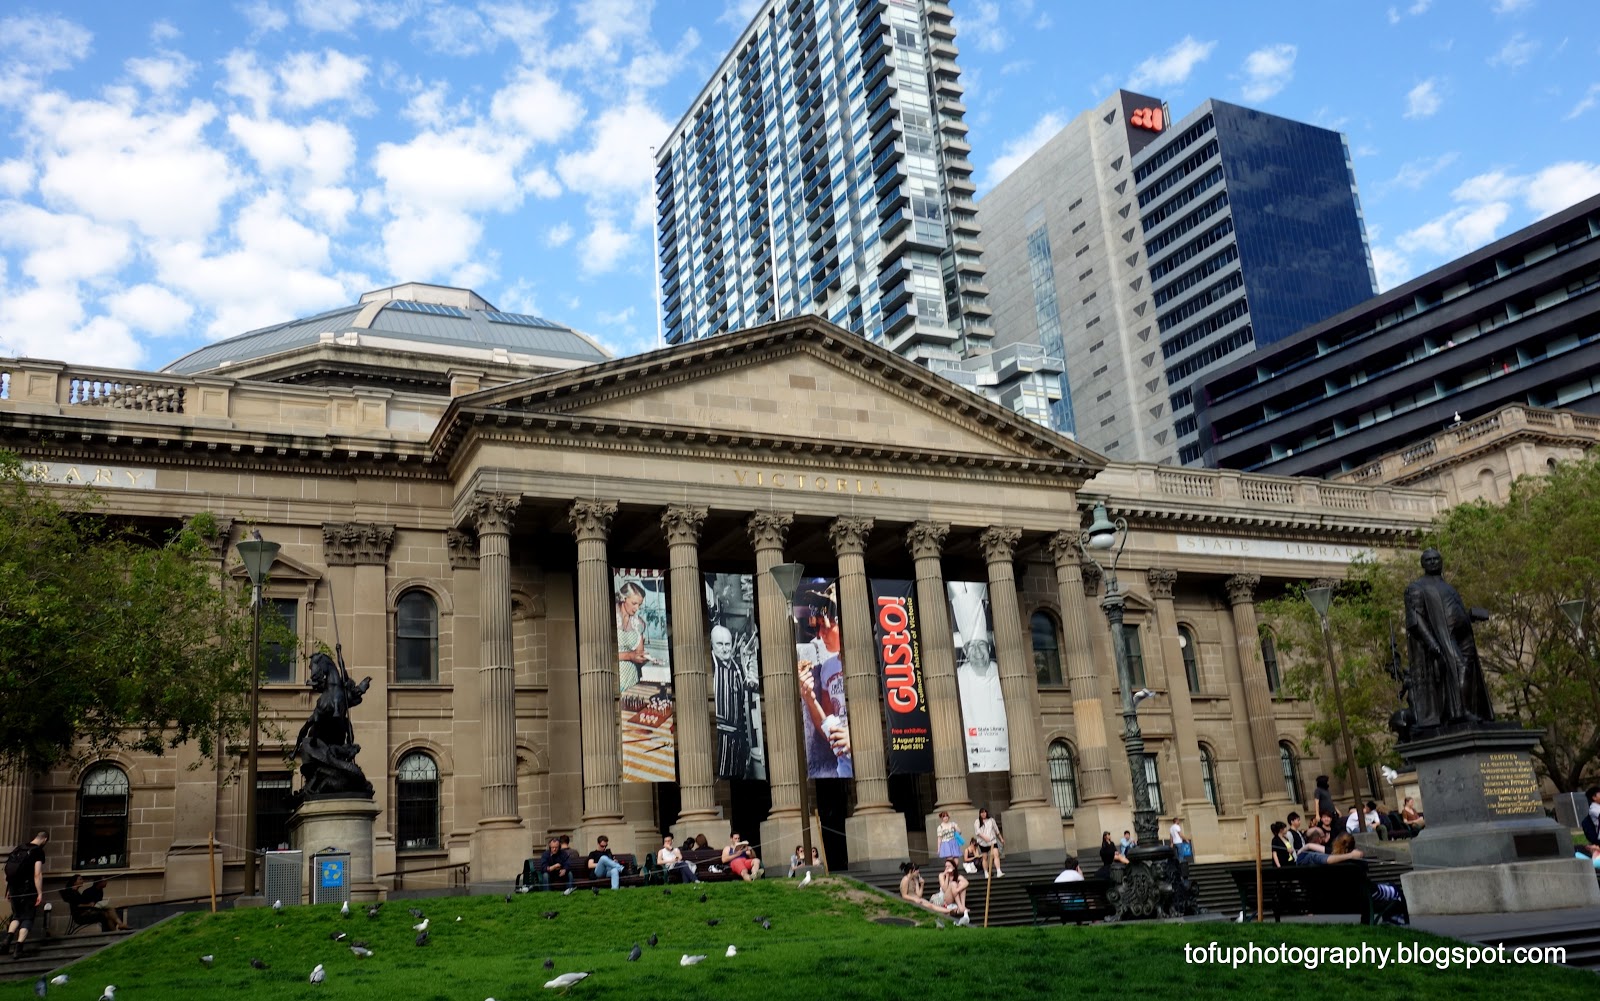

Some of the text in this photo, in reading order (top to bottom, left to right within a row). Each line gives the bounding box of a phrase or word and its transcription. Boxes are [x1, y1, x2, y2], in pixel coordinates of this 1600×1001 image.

[9, 463, 145, 485] RARY
[733, 469, 884, 495] VICTORIA
[1186, 537, 1367, 558] STATE LIBRAR
[907, 597, 916, 628] Victoria
[911, 630, 917, 639] of
[913, 641, 921, 668] history
[916, 669, 925, 703] culinary
[896, 736, 914, 745] August
[914, 736, 926, 744] 2012
[900, 743, 913, 751] April
